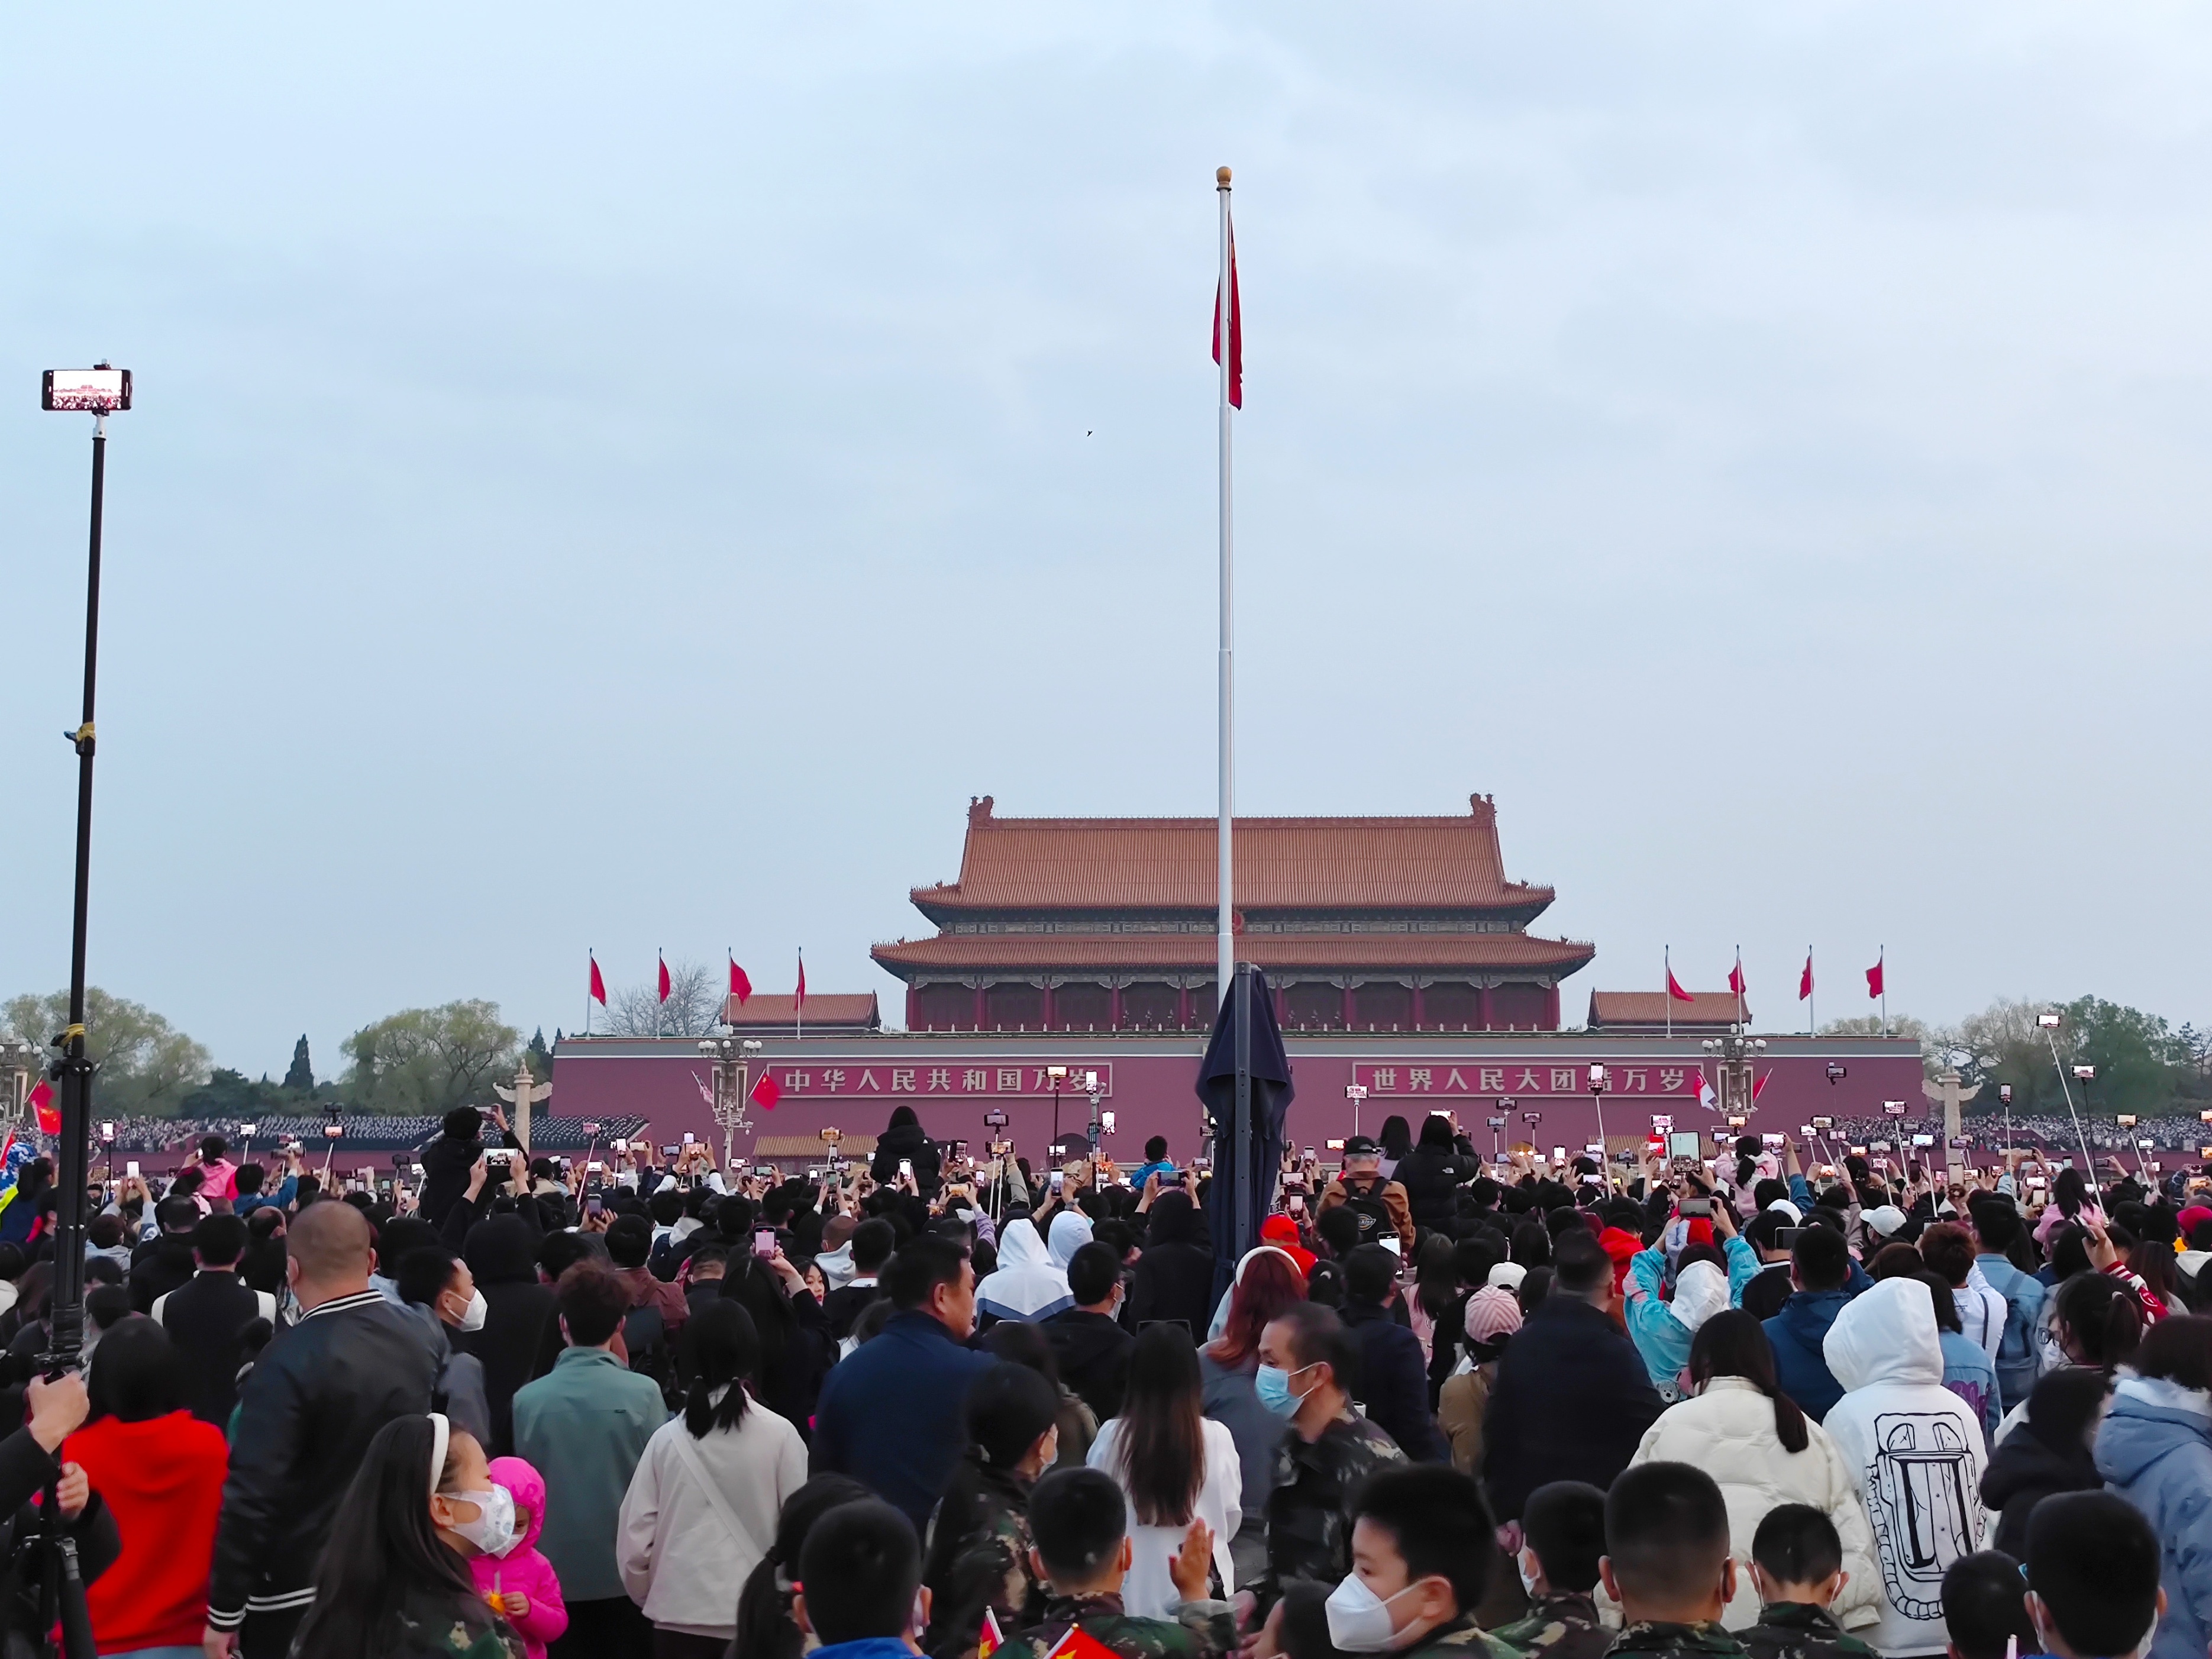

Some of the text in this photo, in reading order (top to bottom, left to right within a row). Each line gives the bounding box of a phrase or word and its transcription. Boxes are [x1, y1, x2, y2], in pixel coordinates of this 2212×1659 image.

[785, 1069, 1087, 1091] 中华人民共和国万岁
